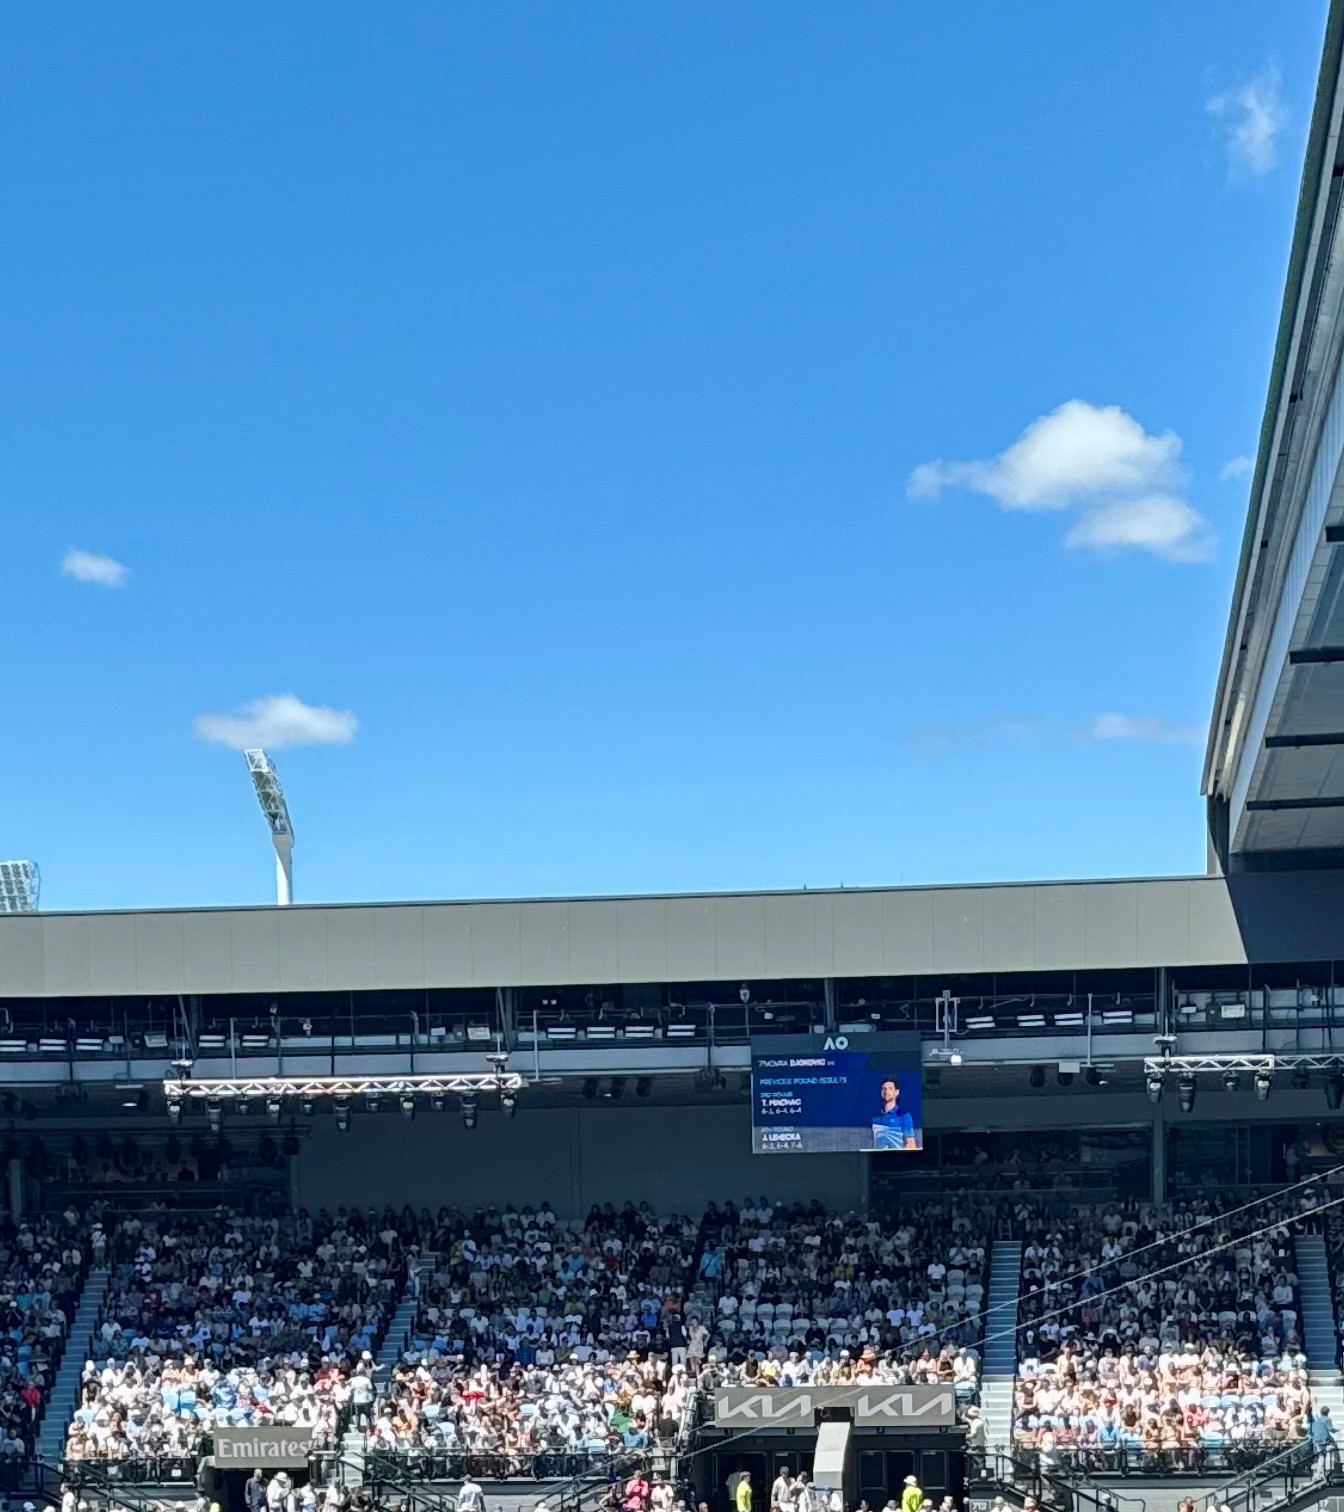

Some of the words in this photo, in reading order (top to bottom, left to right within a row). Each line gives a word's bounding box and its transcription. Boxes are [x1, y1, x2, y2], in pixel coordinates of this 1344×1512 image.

[824, 1036, 848, 1050] AO
[718, 1394, 812, 1418] KIA
[858, 1392, 952, 1416] KIA
[218, 1438, 308, 1458] Emirates
